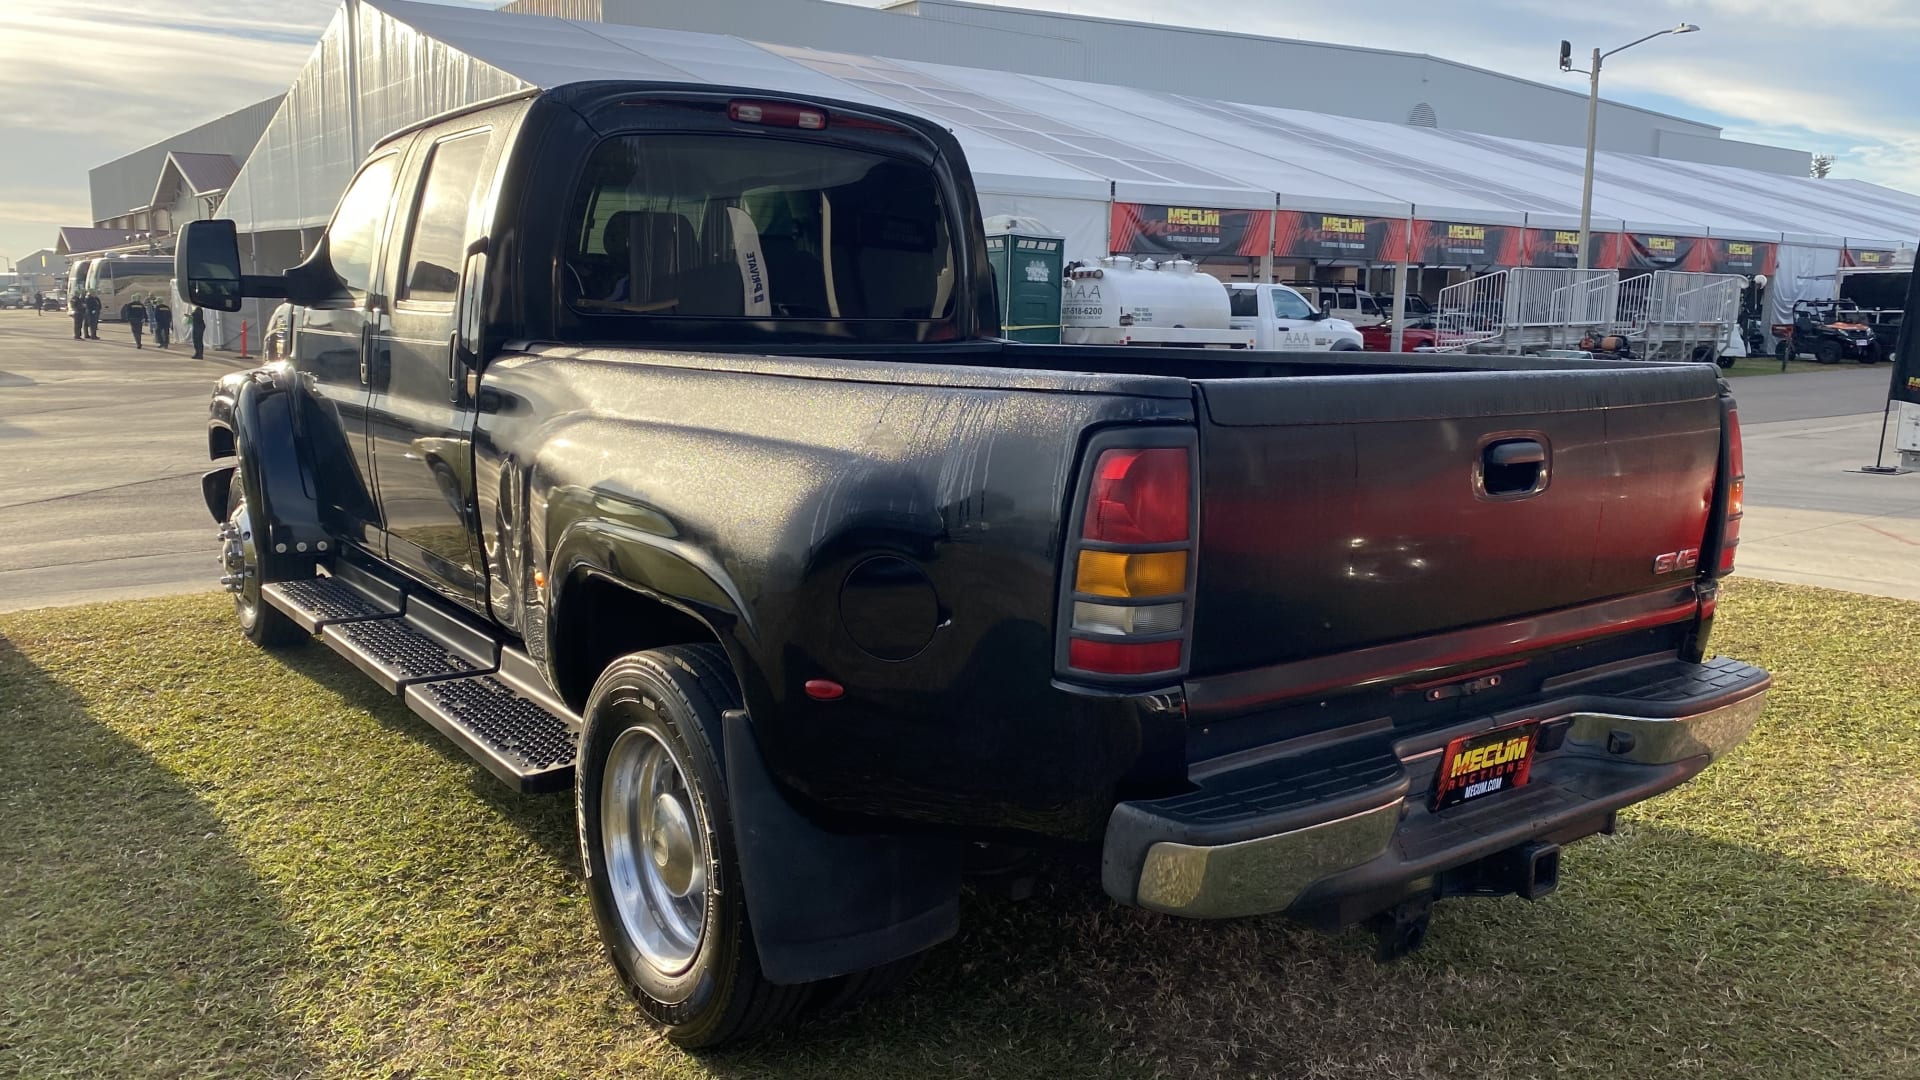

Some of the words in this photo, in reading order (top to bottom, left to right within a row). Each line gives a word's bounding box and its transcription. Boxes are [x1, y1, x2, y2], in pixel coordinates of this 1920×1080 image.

[1168, 208, 1219, 225] MECUM
[1322, 216, 1364, 233] MECUM
[1449, 225, 1484, 240] MECUM
[1555, 231, 1580, 245] MECU
[1285, 333, 1310, 344] AAA
[1451, 736, 1529, 778] MECUM
[1448, 761, 1526, 790] AUCTIONS
[1465, 777, 1502, 799] MECUM.COM
